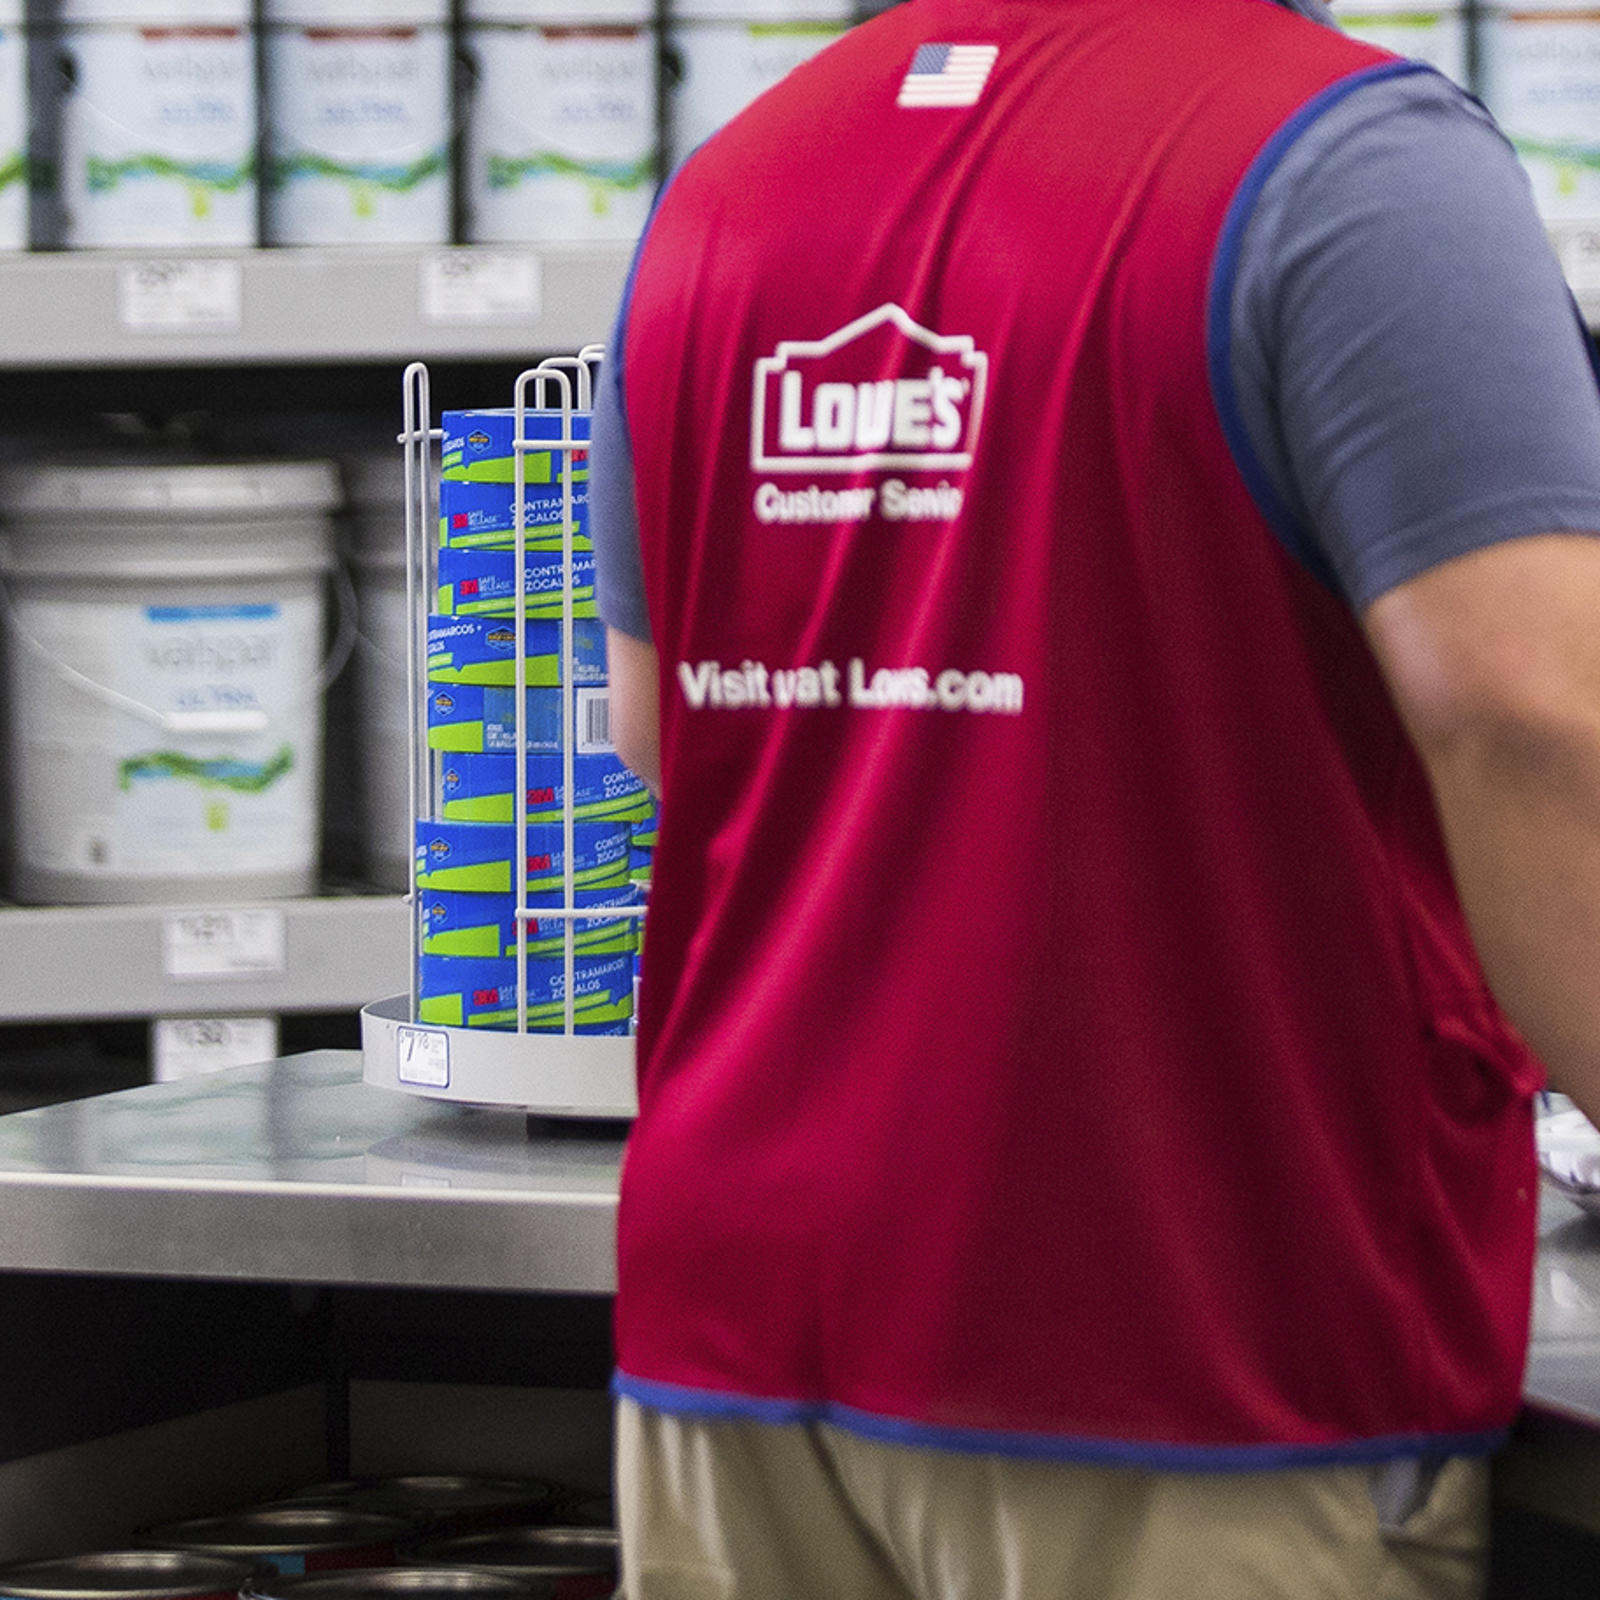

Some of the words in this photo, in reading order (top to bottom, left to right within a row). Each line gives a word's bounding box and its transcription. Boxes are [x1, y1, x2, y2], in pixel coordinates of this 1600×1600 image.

[525, 574, 581, 592] ZOCALS
[550, 957, 626, 987] COTRAMARCOS
[551, 979, 602, 1000] ZOALOS
